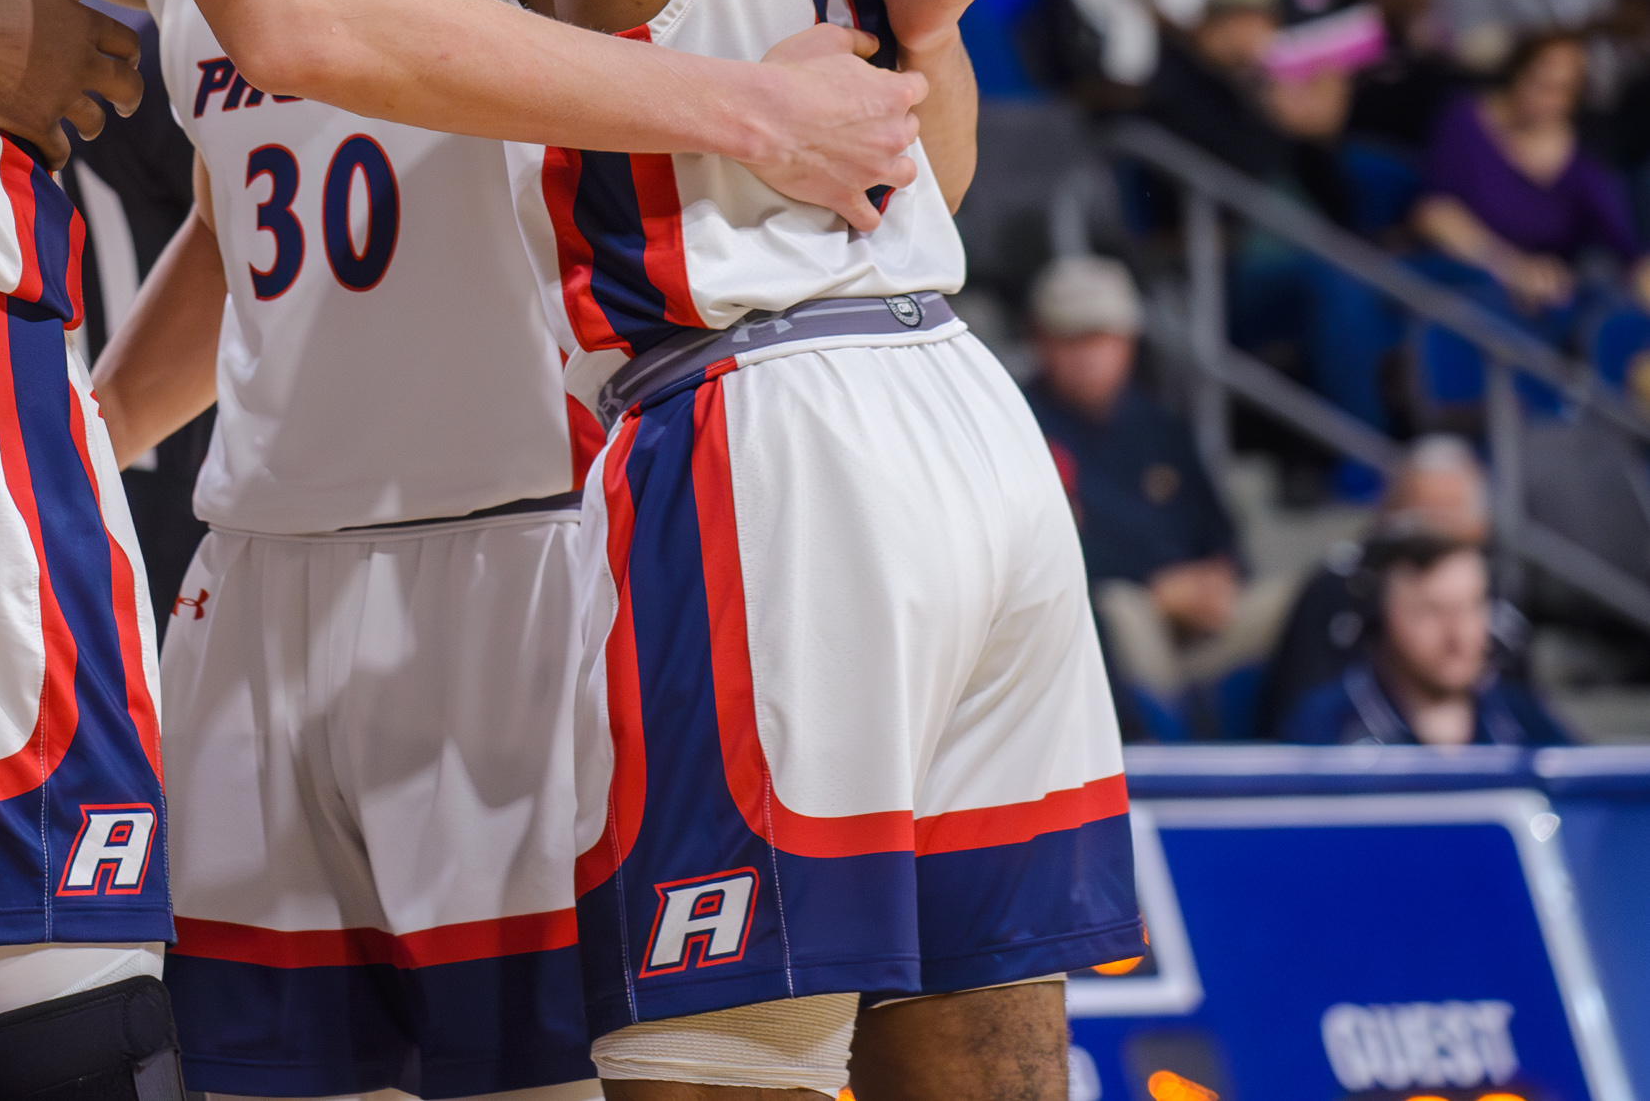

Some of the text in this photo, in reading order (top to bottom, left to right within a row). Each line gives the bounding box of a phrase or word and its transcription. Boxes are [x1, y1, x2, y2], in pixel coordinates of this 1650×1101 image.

[245, 133, 400, 301] 30
[56, 803, 157, 897] A
[639, 867, 759, 978] A
